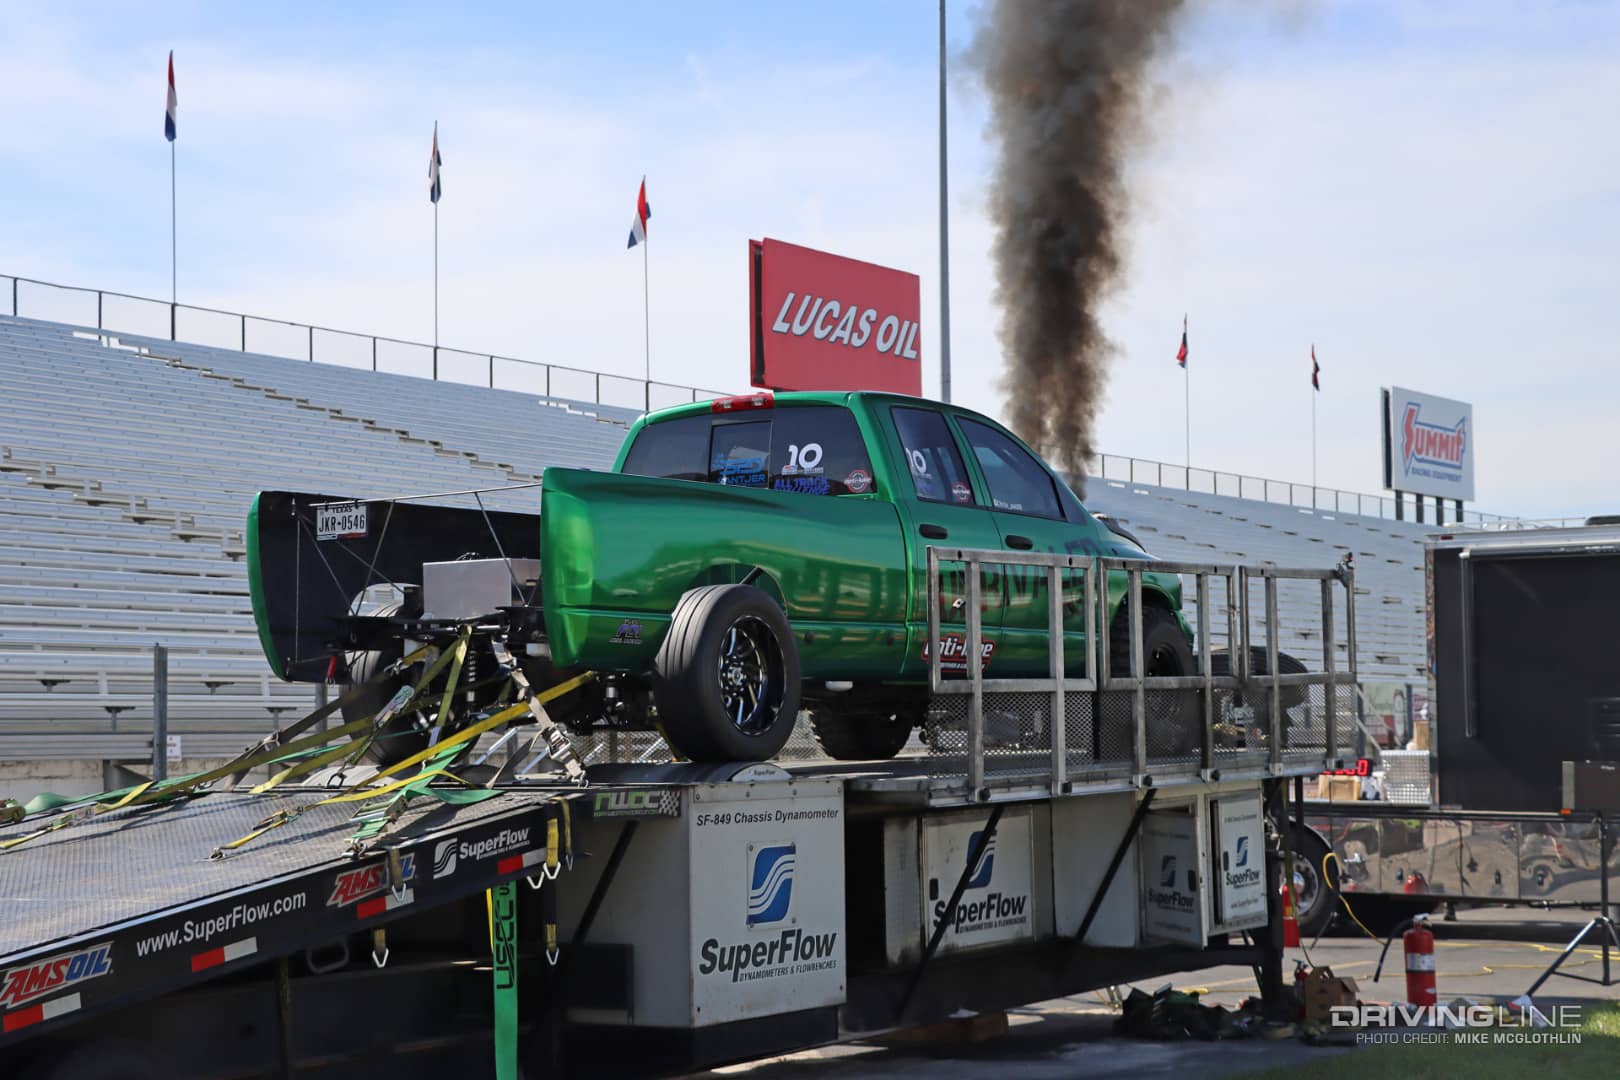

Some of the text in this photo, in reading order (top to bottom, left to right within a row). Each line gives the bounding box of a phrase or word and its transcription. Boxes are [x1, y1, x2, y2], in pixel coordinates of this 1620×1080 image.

[772, 291, 919, 360] LUCAS OIL
[788, 442, 823, 469] 10
[1404, 406, 1464, 464] SUMMIT
[696, 808, 839, 827] SF-849 Chassis Dynamometer
[459, 827, 530, 861] SuperFlow
[332, 852, 415, 904] AMSIL
[136, 891, 307, 957] www.SuperFlow.com
[933, 892, 1027, 934] SperFlow
[0, 945, 113, 1003] AMSOIL
[699, 928, 837, 983] SuperFlow
[739, 966, 789, 983] DYNAMOMETERS
[796, 959, 837, 974] FLOWBENCHES
